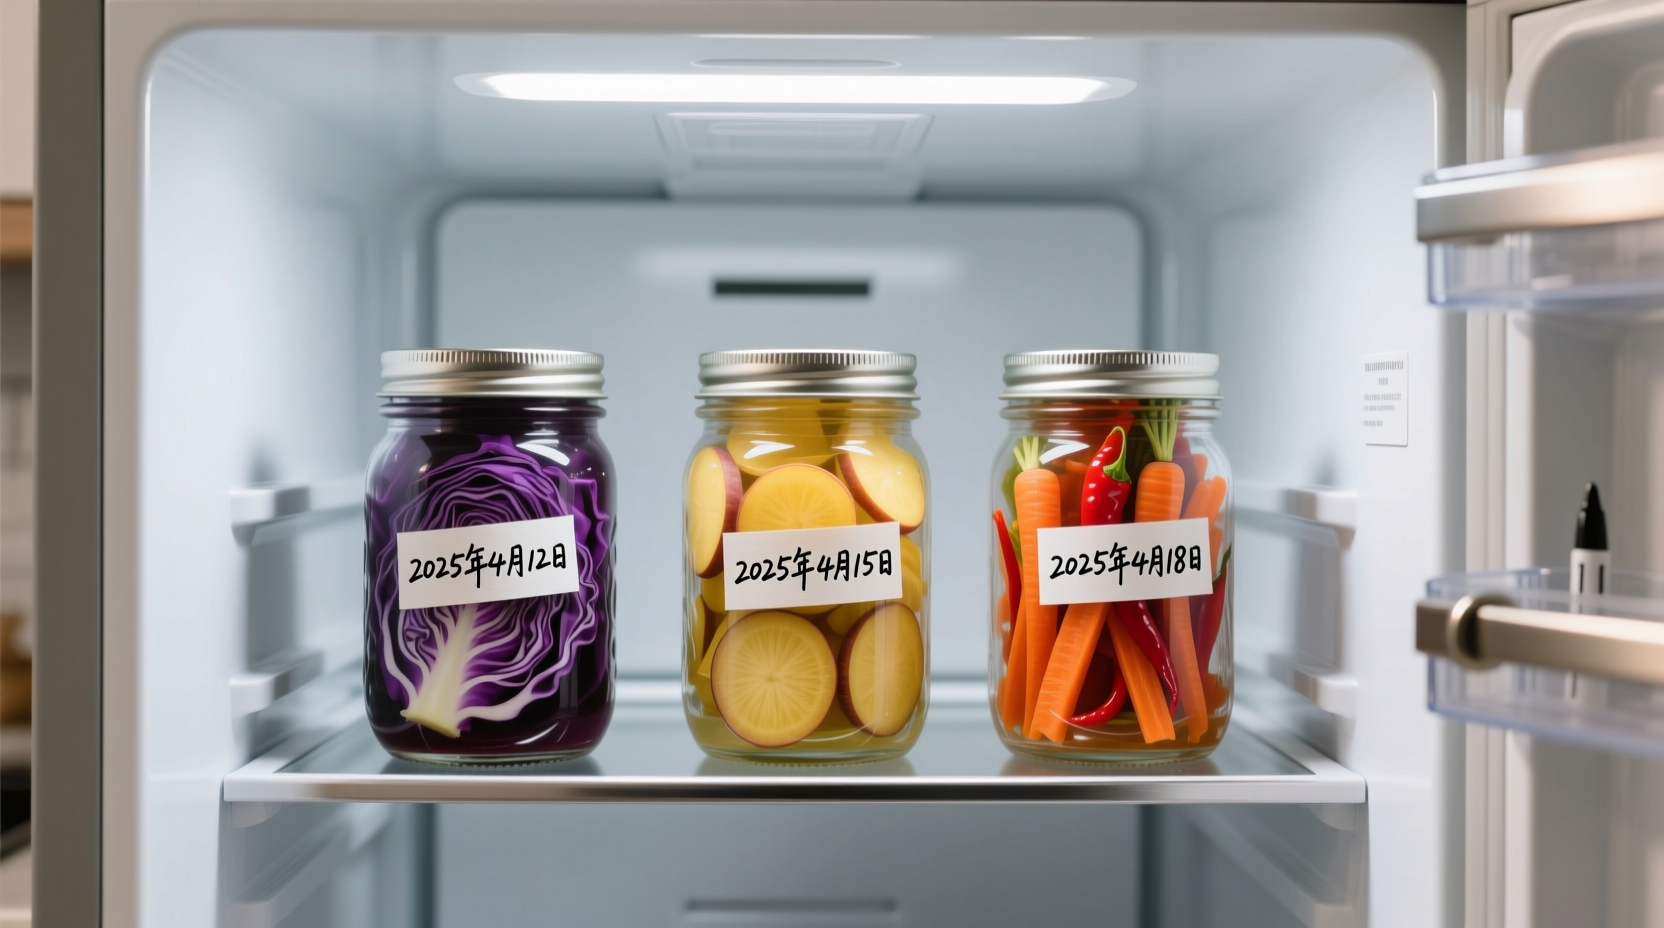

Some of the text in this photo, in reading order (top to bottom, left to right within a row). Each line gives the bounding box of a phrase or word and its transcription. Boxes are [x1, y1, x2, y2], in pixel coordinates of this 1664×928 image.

[408, 543, 567, 589] 2025年4月12日
[734, 546, 892, 592] 2025年4月15日
[1049, 541, 1201, 586] 2025年4月18日
